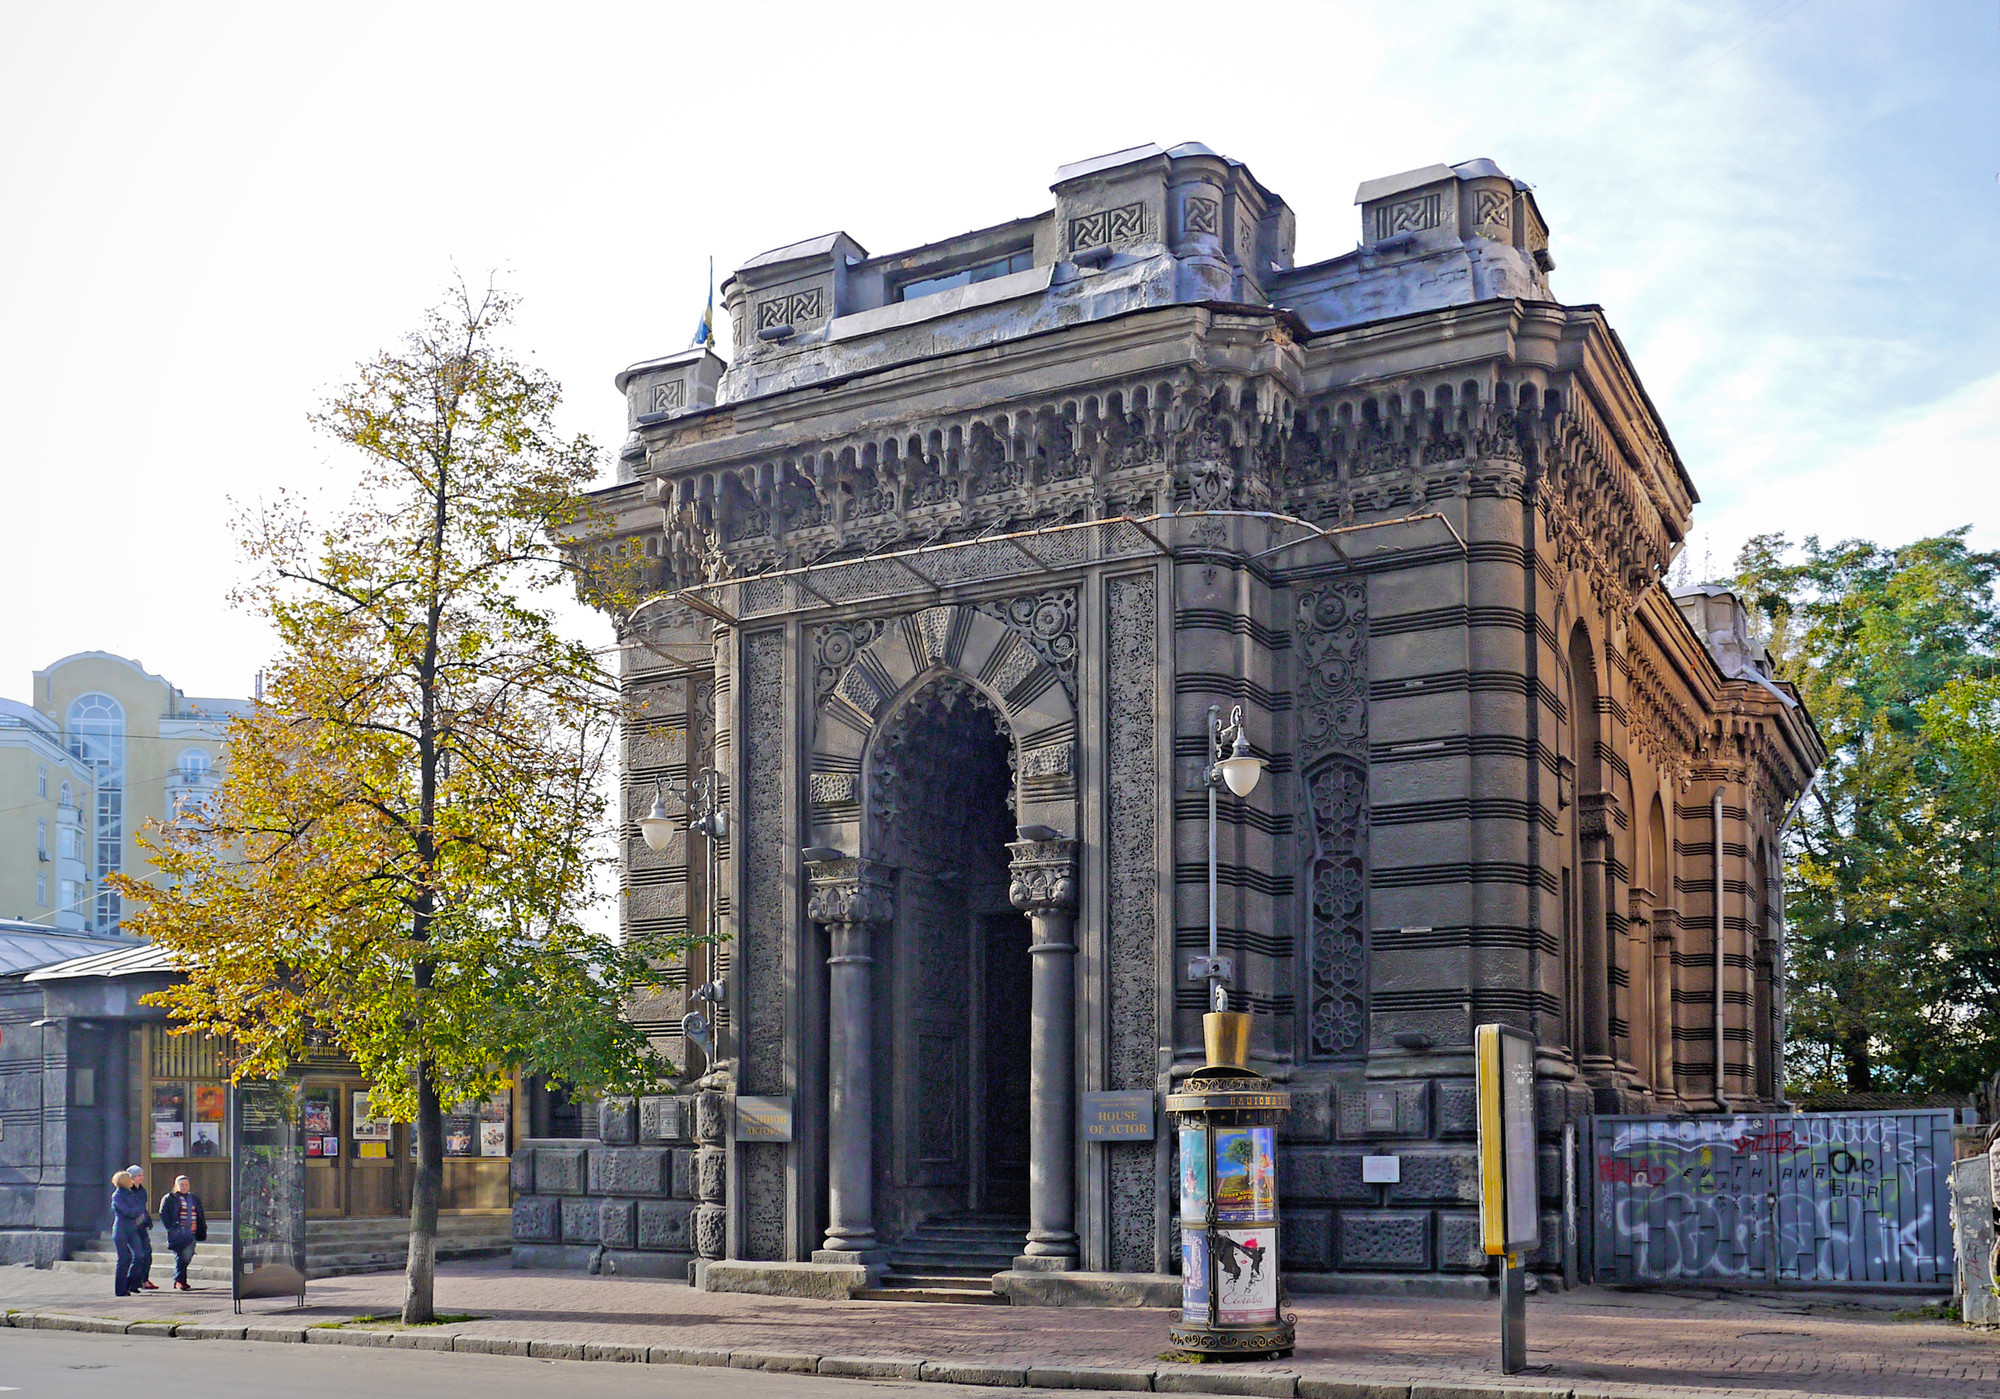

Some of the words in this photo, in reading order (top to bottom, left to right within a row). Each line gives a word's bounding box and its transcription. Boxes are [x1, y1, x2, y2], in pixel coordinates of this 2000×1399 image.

[1098, 1111, 1138, 1121] HOUSE
[1089, 1125, 1104, 1135] OF
[1110, 1124, 1147, 1134] ACTOR
